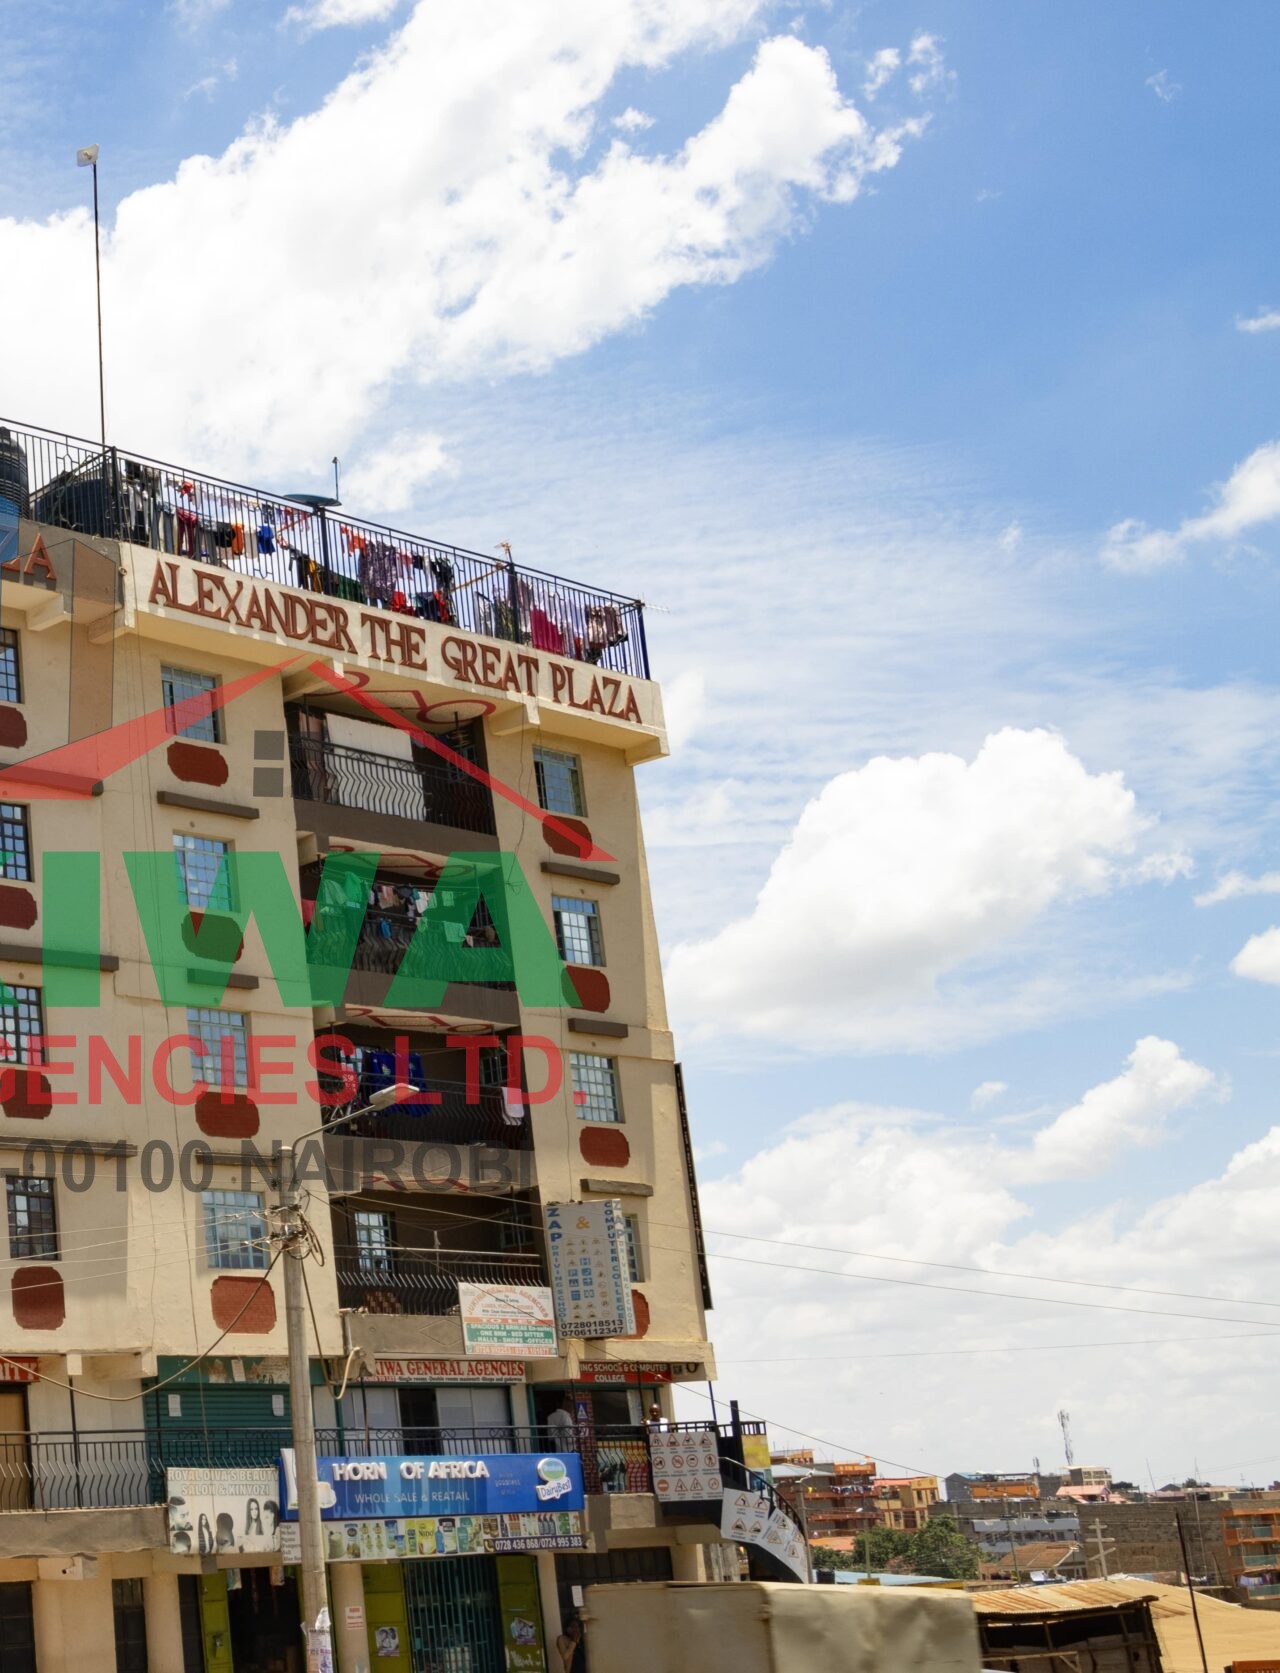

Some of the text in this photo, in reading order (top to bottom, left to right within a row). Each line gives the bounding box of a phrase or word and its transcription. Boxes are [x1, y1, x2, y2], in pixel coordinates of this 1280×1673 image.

[149, 560, 642, 724] ALEXANDER THE GREAT PLAZA
[547, 1208, 562, 1242] ZAP
[576, 1216, 590, 1229] &
[604, 1201, 625, 1319] COMPUTER COLLEGE
[561, 1320, 624, 1330] 0728018513
[561, 1327, 624, 1337] 0706112347
[407, 1361, 463, 1376] GENERAL
[467, 1361, 524, 1376] AGENCIES
[593, 1363, 622, 1373] SCHOOL
[623, 1363, 628, 1372] &
[594, 1374, 626, 1383] COLLEGE
[168, 1470, 202, 1482] ROYAL
[240, 1469, 279, 1482] BEAUTY
[332, 1461, 490, 1481] HORN OF AFRICA
[182, 1483, 217, 1496] SALON
[218, 1484, 227, 1496] &
[541, 1477, 572, 1499] DairyBest
[355, 1493, 390, 1504] WHOLE
[393, 1493, 417, 1503] SALE
[432, 1491, 470, 1502] REATAIL
[495, 1540, 511, 1551] 0728
[512, 1539, 525, 1550] 436
[557, 1536, 569, 1548] 995
[570, 1535, 583, 1547] 383
